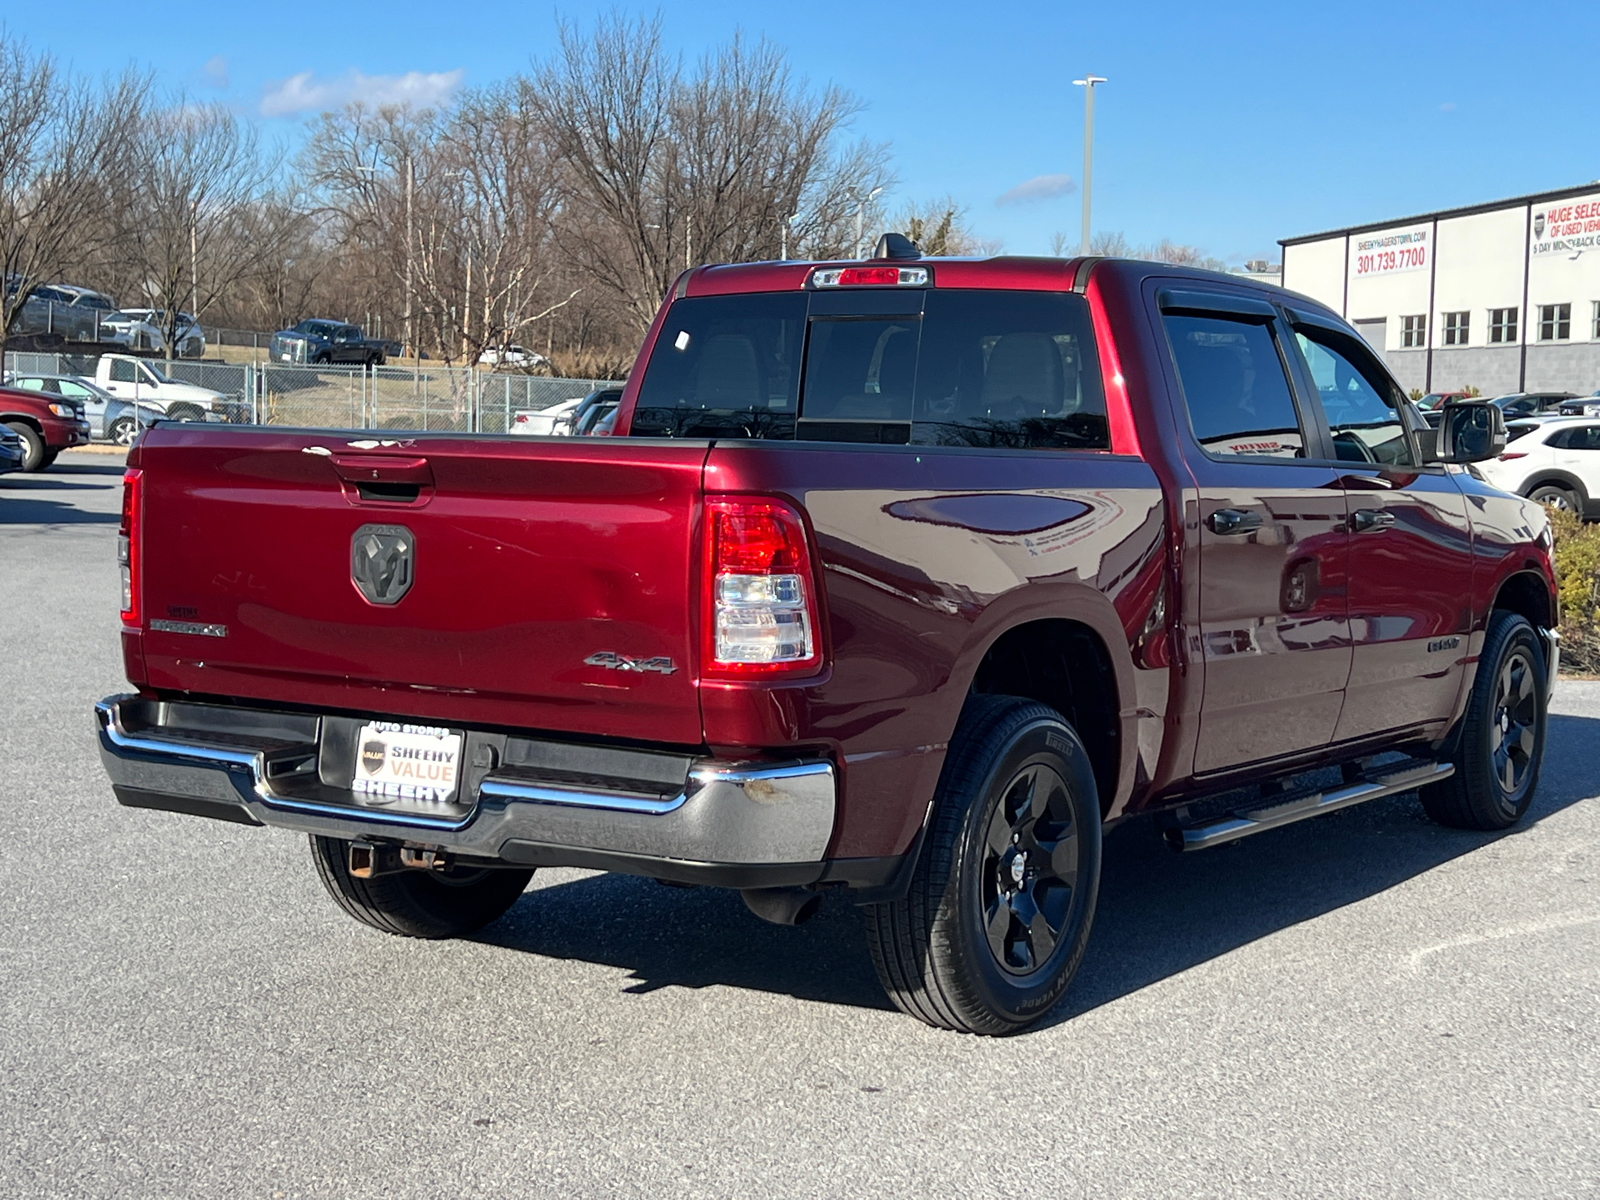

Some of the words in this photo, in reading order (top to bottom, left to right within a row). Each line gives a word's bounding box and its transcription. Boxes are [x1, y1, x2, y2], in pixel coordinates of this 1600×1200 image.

[1547, 206, 1573, 225] HUGE
[1551, 225, 1561, 237] OF
[1562, 222, 1582, 236] USED
[1539, 242, 1551, 253] DAY
[1357, 246, 1425, 274] 301.739.7700
[1045, 731, 1074, 757] PIRELLI
[391, 746, 455, 763] SHEEHY
[391, 760, 454, 782] VALUE
[352, 778, 454, 802] SHEEHY
